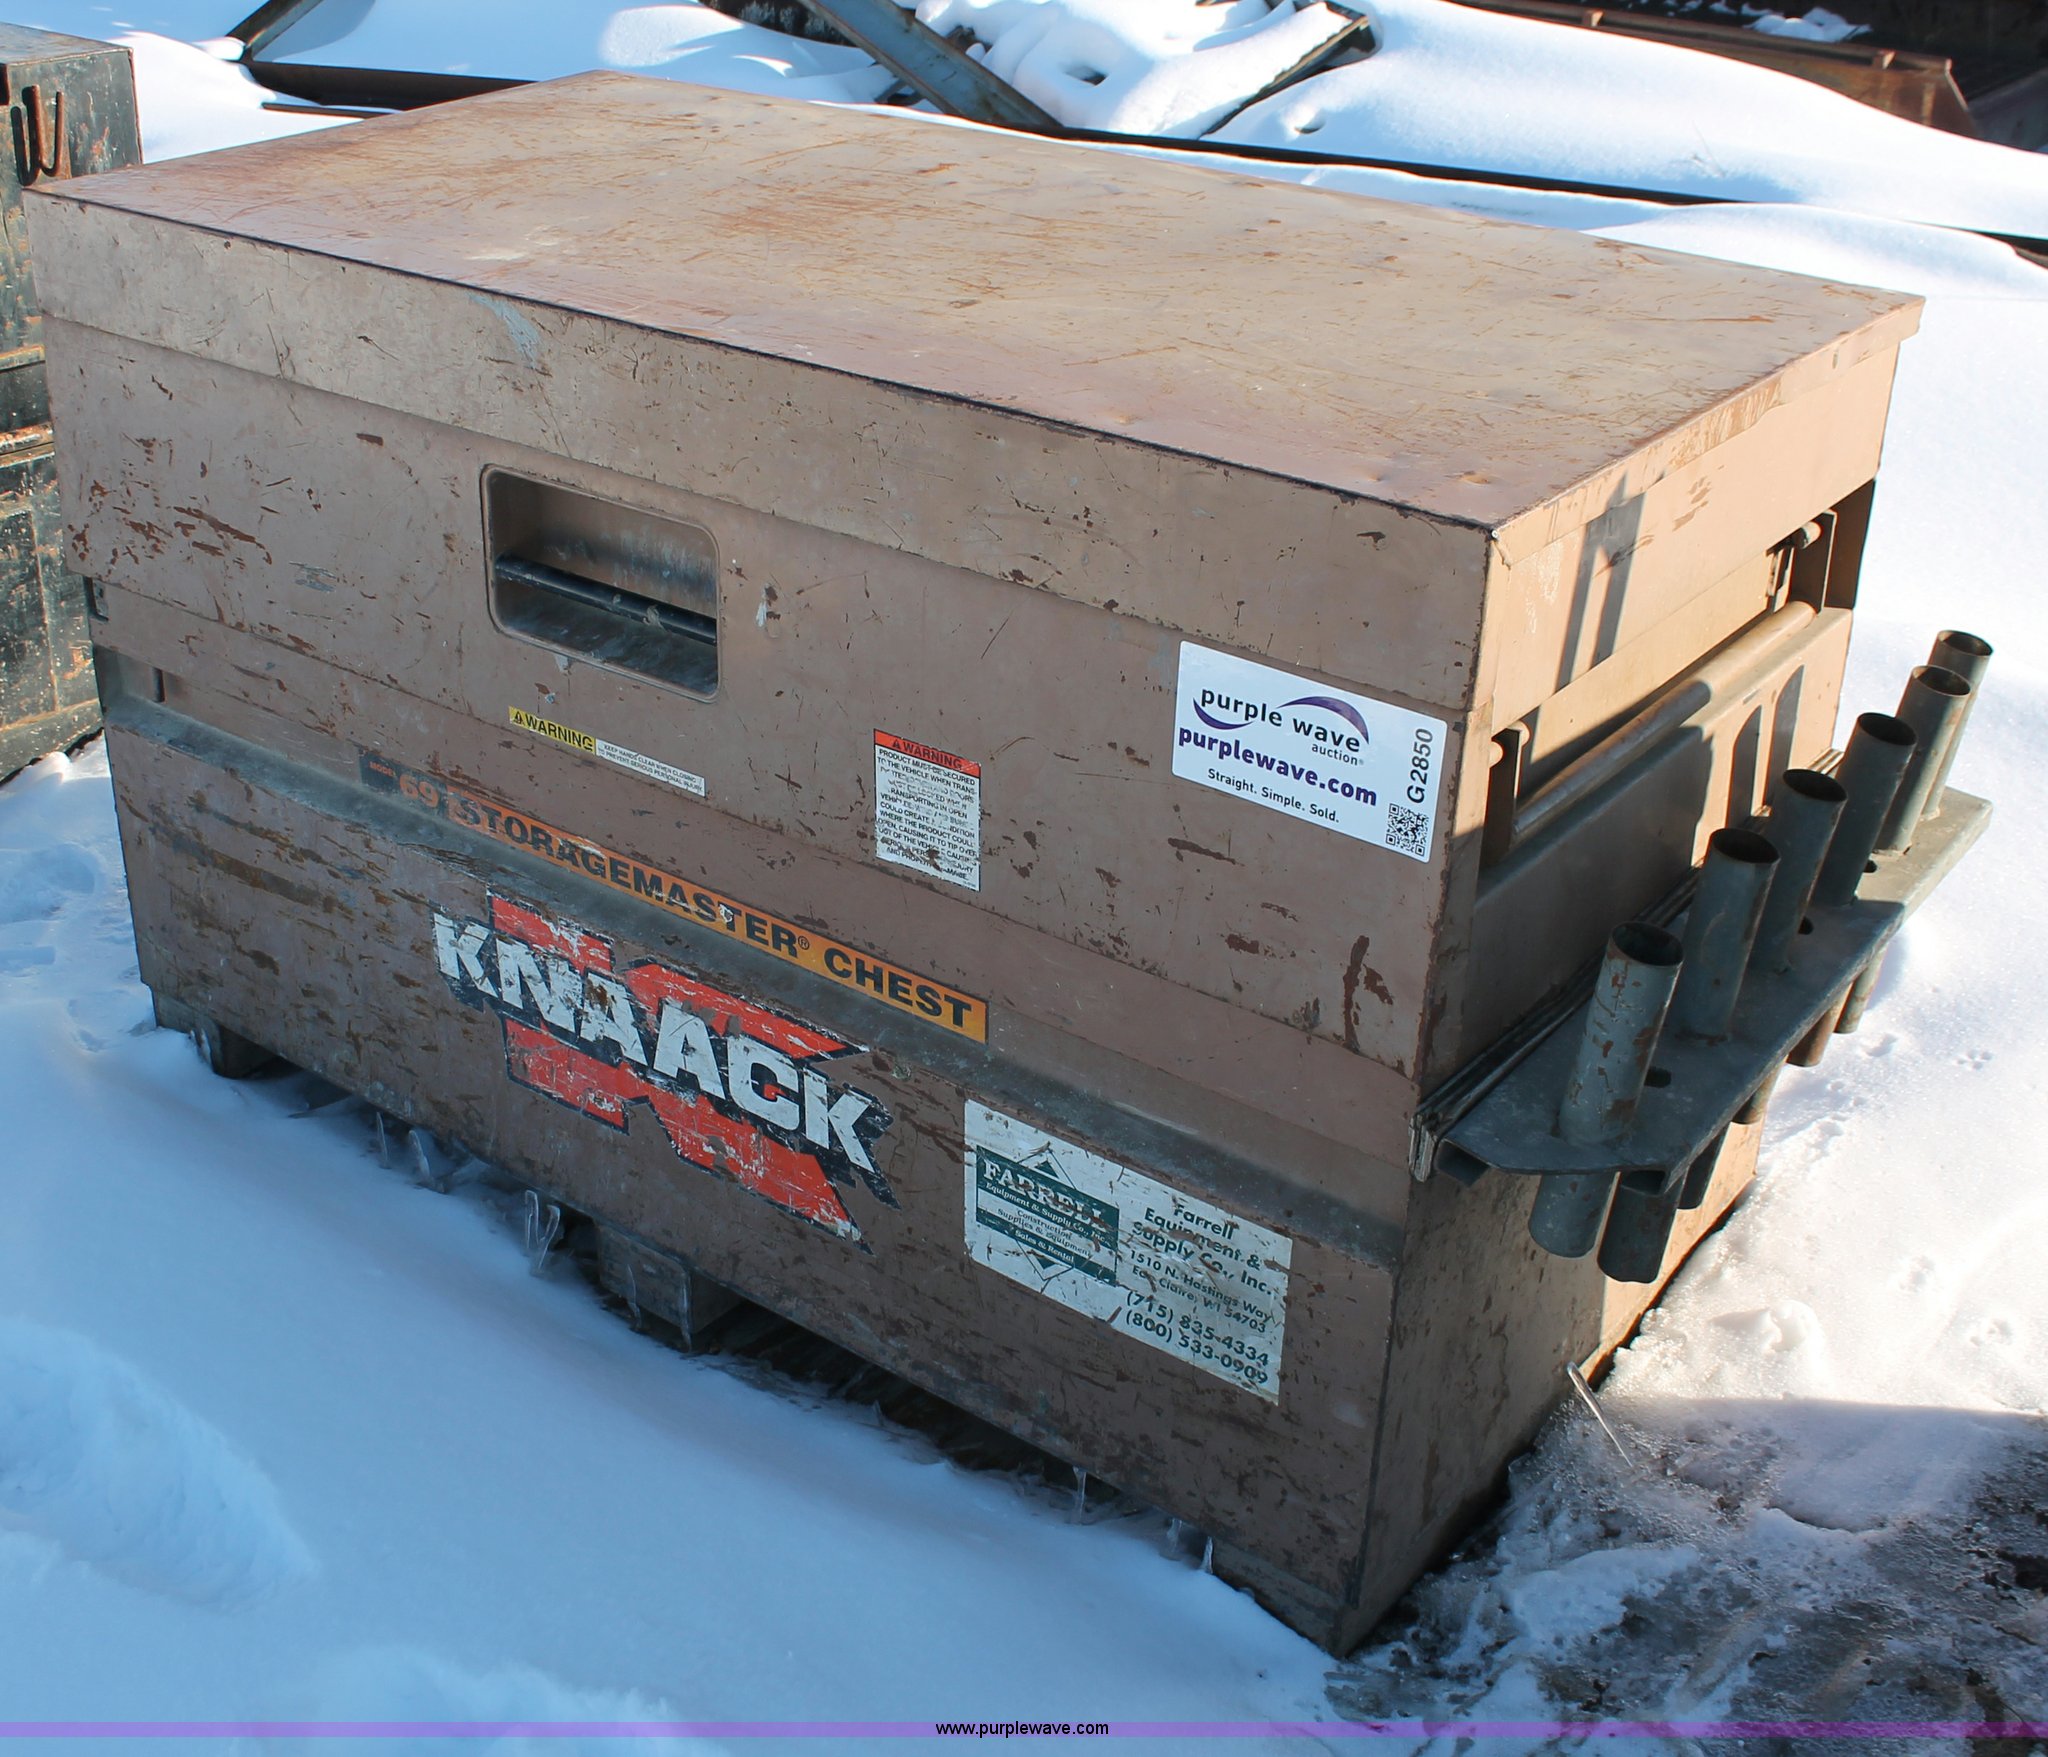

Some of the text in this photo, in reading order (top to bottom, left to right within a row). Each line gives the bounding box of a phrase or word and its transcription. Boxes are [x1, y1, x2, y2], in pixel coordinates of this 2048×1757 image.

[525, 715, 593, 752] WARNING
[1201, 688, 1360, 753] purple wave
[604, 745, 696, 783] KEEP HANDS CLEAR WHEN CLOSING
[606, 751, 630, 764] PREVENT
[630, 759, 653, 773] SERIOUS
[654, 769, 682, 785] PERSONAL
[879, 749, 910, 764] PRODUCT
[943, 769, 975, 786] SECURED
[887, 759, 900, 770] THE
[901, 764, 929, 780] VEHICLE
[930, 775, 952, 788] WHEN
[903, 741, 962, 769] WARNING
[1179, 726, 1377, 806] purplewave.com
[1407, 728, 1433, 804] G2850
[400, 774, 439, 808] 69
[888, 788, 939, 810] RANSPORTING
[939, 803, 947, 812] IN
[948, 807, 968, 819] OPEN
[1208, 768, 1340, 823] Straight. Simple. Sold.
[880, 802, 903, 814] COULD
[903, 809, 932, 823] CREATE
[880, 810, 904, 823] WHERE
[904, 818, 918, 828] THE
[918, 824, 951, 840] PRODUCT
[892, 832, 902, 840] OF
[903, 835, 917, 846] THE
[898, 825, 928, 841] CAUSING
[929, 835, 936, 843] IT
[937, 838, 947, 847] TO
[948, 842, 958, 851] TIP
[822, 947, 973, 1030] CHEST
[432, 911, 875, 1173] KNAACK
[983, 1159, 1107, 1232] FARRELL
[986, 1182, 1030, 1208] Equipment
[1032, 1203, 1040, 1211] &
[1041, 1209, 1071, 1230] Supply
[998, 1208, 1092, 1258] Supplies & Equipment
[1017, 1210, 1072, 1239] Construction
[1173, 1203, 1234, 1240] Farrell
[1014, 1230, 1074, 1262] Sales & Rental
[1132, 1221, 1195, 1261] Supply
[1240, 1270, 1272, 1295] Inc.
[1246, 1254, 1262, 1272] &
[1130, 1250, 1272, 1324] 1510 N. Hastings Way
[1132, 1265, 1156, 1285] Ea
[1203, 1297, 1220, 1312] WI
[1224, 1306, 1266, 1333] 54703
[1126, 1310, 1268, 1384] (800) 533-0909
[1127, 1291, 1269, 1366] (715) 835-4334
